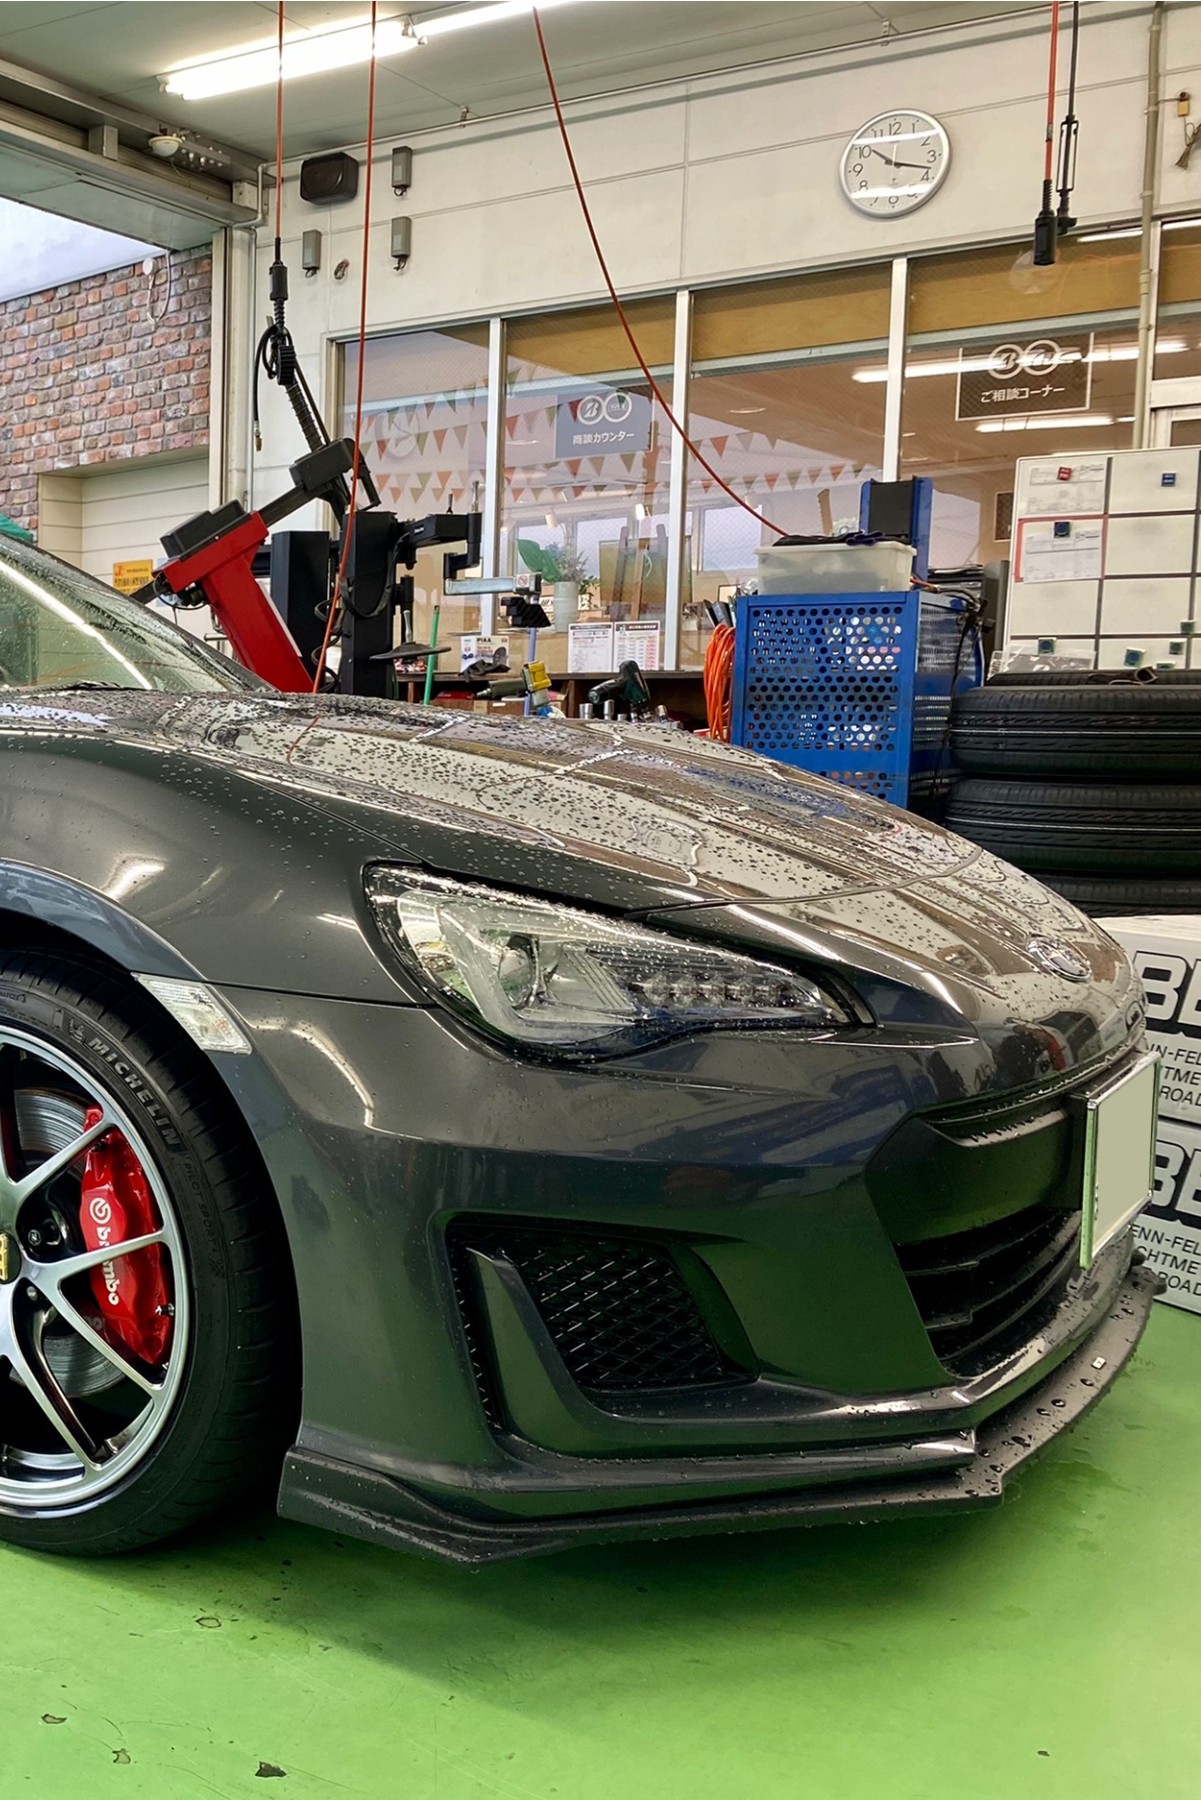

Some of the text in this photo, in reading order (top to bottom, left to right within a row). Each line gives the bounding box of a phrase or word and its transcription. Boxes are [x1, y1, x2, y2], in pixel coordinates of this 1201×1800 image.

[889, 122, 902, 136] 12
[859, 144, 872, 159] 10
[927, 149, 937, 163] 3
[852, 163, 864, 177] 9
[921, 169, 930, 182] 4
[980, 384, 1065, 403] ご相談コーナー
[572, 430, 635, 446] 商談カウンター
[1163, 1065, 1201, 1086] TME
[88, 1037, 181, 1148] MICHELIN
[183, 1161, 202, 1197] PILOT
[198, 1202, 217, 1245] SPORT
[96, 1226, 120, 1306] brmbo
